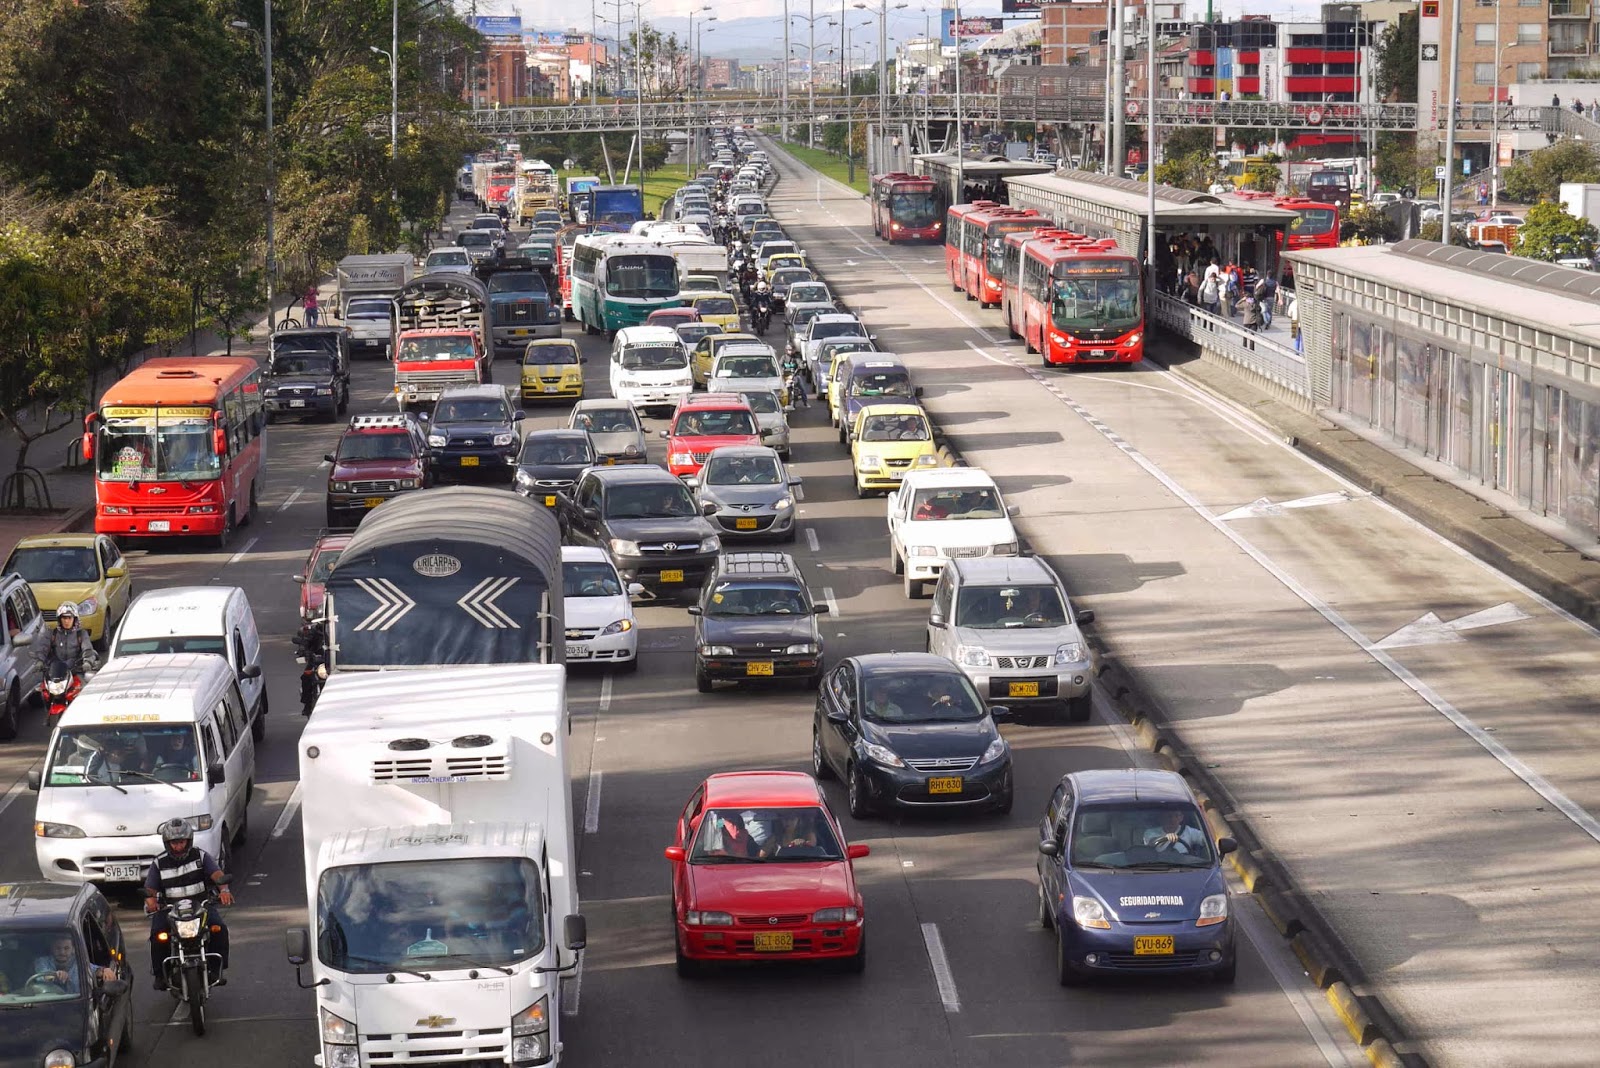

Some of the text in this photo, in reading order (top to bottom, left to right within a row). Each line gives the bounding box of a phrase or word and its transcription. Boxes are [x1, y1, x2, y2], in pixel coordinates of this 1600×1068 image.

[1436, 167, 1444, 175] P
[1119, 895, 1184, 907] SEGURIDAD PRIVADA
